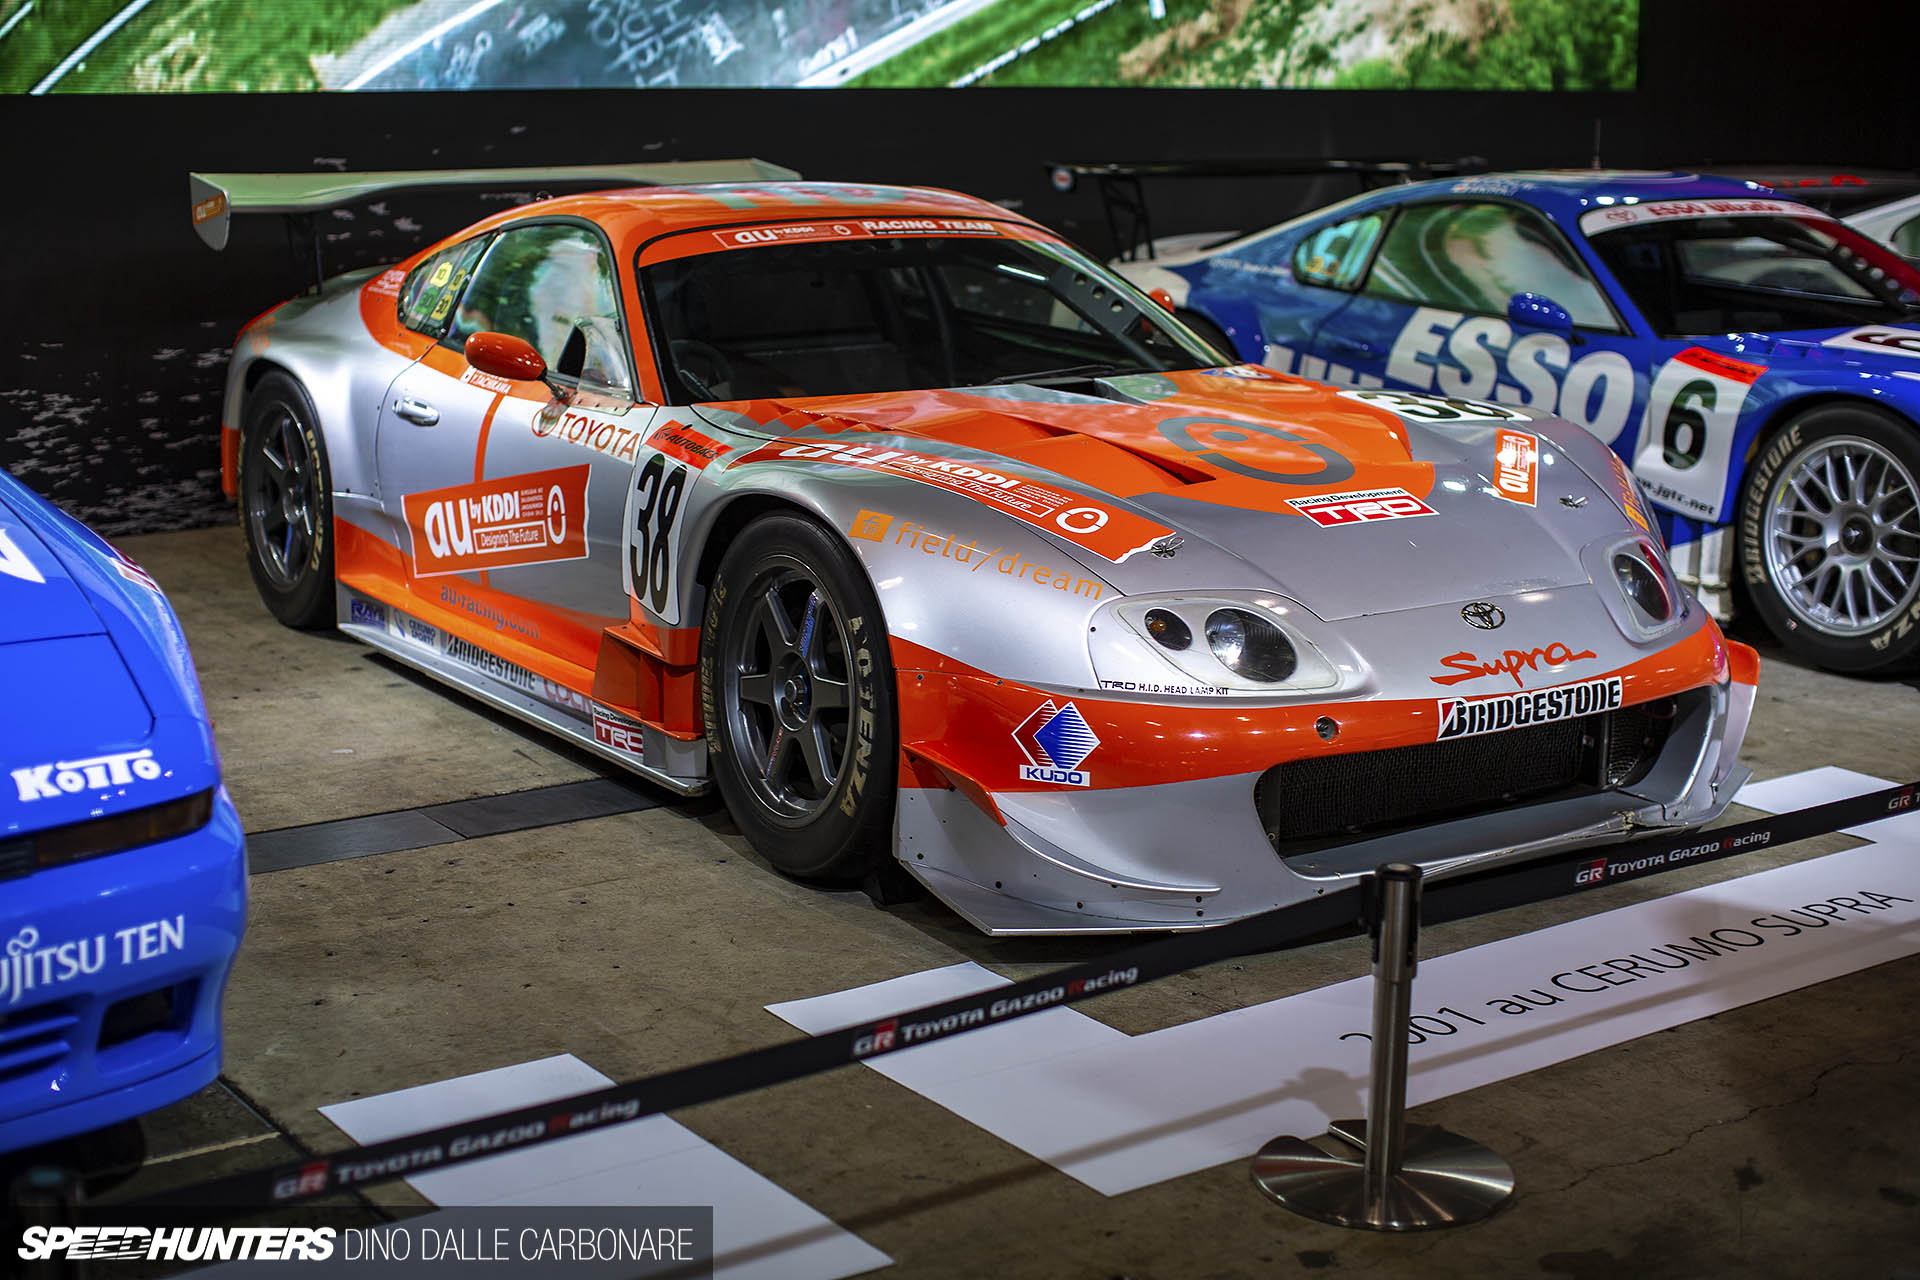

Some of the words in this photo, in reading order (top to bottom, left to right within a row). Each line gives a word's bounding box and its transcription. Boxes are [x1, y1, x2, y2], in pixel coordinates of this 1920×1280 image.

[734, 230, 779, 243] au
[862, 220, 937, 231] RACING
[942, 220, 996, 231] TEAM
[1385, 306, 1635, 448] ESSO
[557, 412, 640, 461] TOYOTA
[668, 433, 720, 460] AUTOBACS
[1662, 379, 1717, 470] 6
[779, 443, 905, 465] au
[928, 461, 1021, 489] KDDI
[967, 481, 990, 494] The
[988, 489, 1033, 509] Future
[1289, 495, 1331, 506] Racing
[1331, 488, 1405, 501] Development
[1307, 498, 1422, 520] TRD
[1744, 424, 1803, 584] BRIDGESTONE
[424, 498, 474, 559] au
[469, 497, 482, 524] by
[481, 490, 520, 523] KDDI
[481, 532, 509, 549] Designing
[508, 530, 520, 544] The
[519, 527, 539, 544] Future
[630, 453, 688, 613] 38
[895, 521, 1103, 600] field/dream
[446, 632, 537, 691] BRIDGESTONE
[1100, 679, 1136, 690] TRD
[1138, 683, 1162, 693] H.I.D.
[1163, 685, 1188, 694] HEAD
[1215, 687, 1230, 696] KIT
[1429, 641, 1598, 689] Supra
[1438, 678, 1622, 740] BRIDGESTONE
[1026, 766, 1083, 785] KUDO
[1888, 793, 1911, 809] GR
[1575, 862, 1606, 884] GR
[1608, 853, 1666, 877] TOYOTA
[1669, 840, 1720, 863] GAZOO
[1722, 830, 1772, 850] Racing
[114, 913, 185, 965] TEN
[1485, 986, 1565, 1017] au
[1550, 926, 1766, 994] CERUMO
[1752, 889, 1915, 938] SUPRA
[853, 1026, 897, 1056] GR
[901, 1006, 986, 1043] TOYOTA
[989, 985, 1065, 1020] GAZOO
[1067, 965, 1140, 999] Racing
[273, 1166, 328, 1200] GR
[336, 1145, 444, 1185] TOYOTA
[448, 1119, 547, 1158] GAZOO
[550, 1098, 641, 1136] Racing
